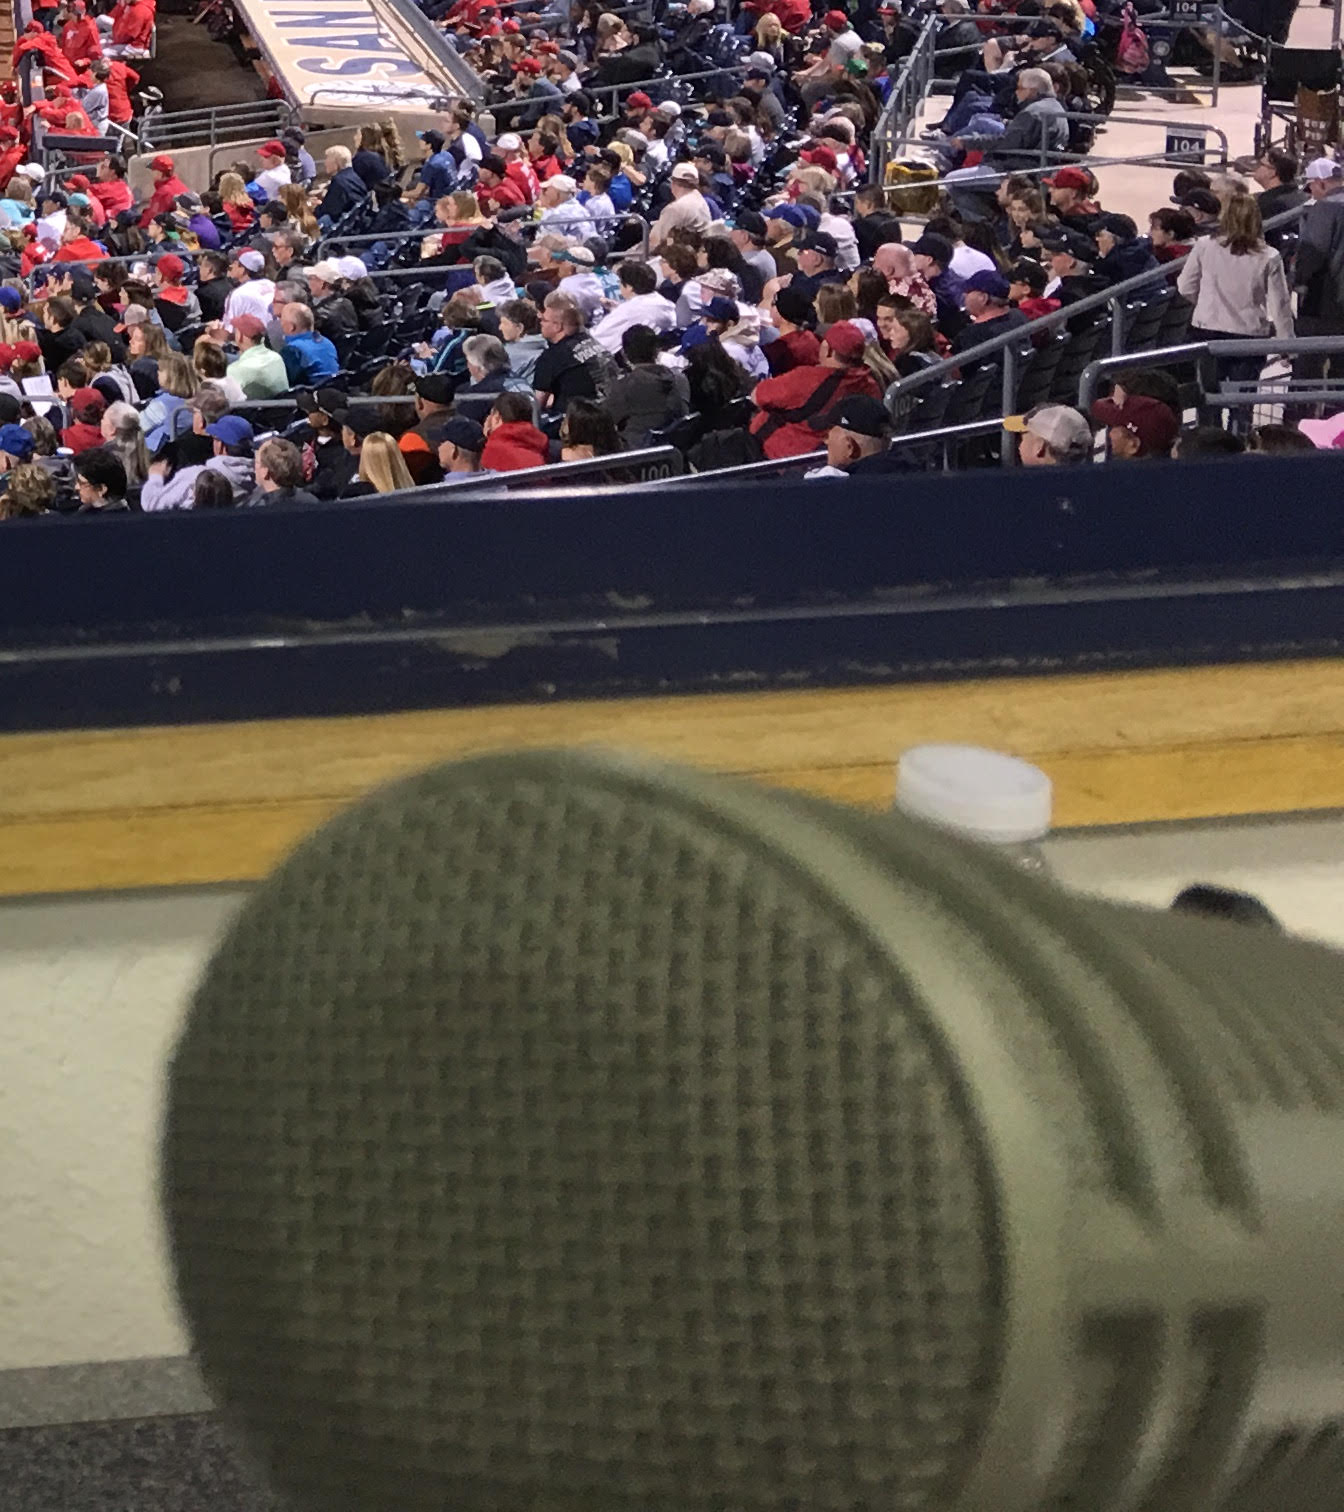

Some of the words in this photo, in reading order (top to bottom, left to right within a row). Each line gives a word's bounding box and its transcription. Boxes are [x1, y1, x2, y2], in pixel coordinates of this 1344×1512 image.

[1175, 1, 1197, 12] 104
[266, 9, 426, 77] SAN
[1173, 139, 1200, 153] 104
